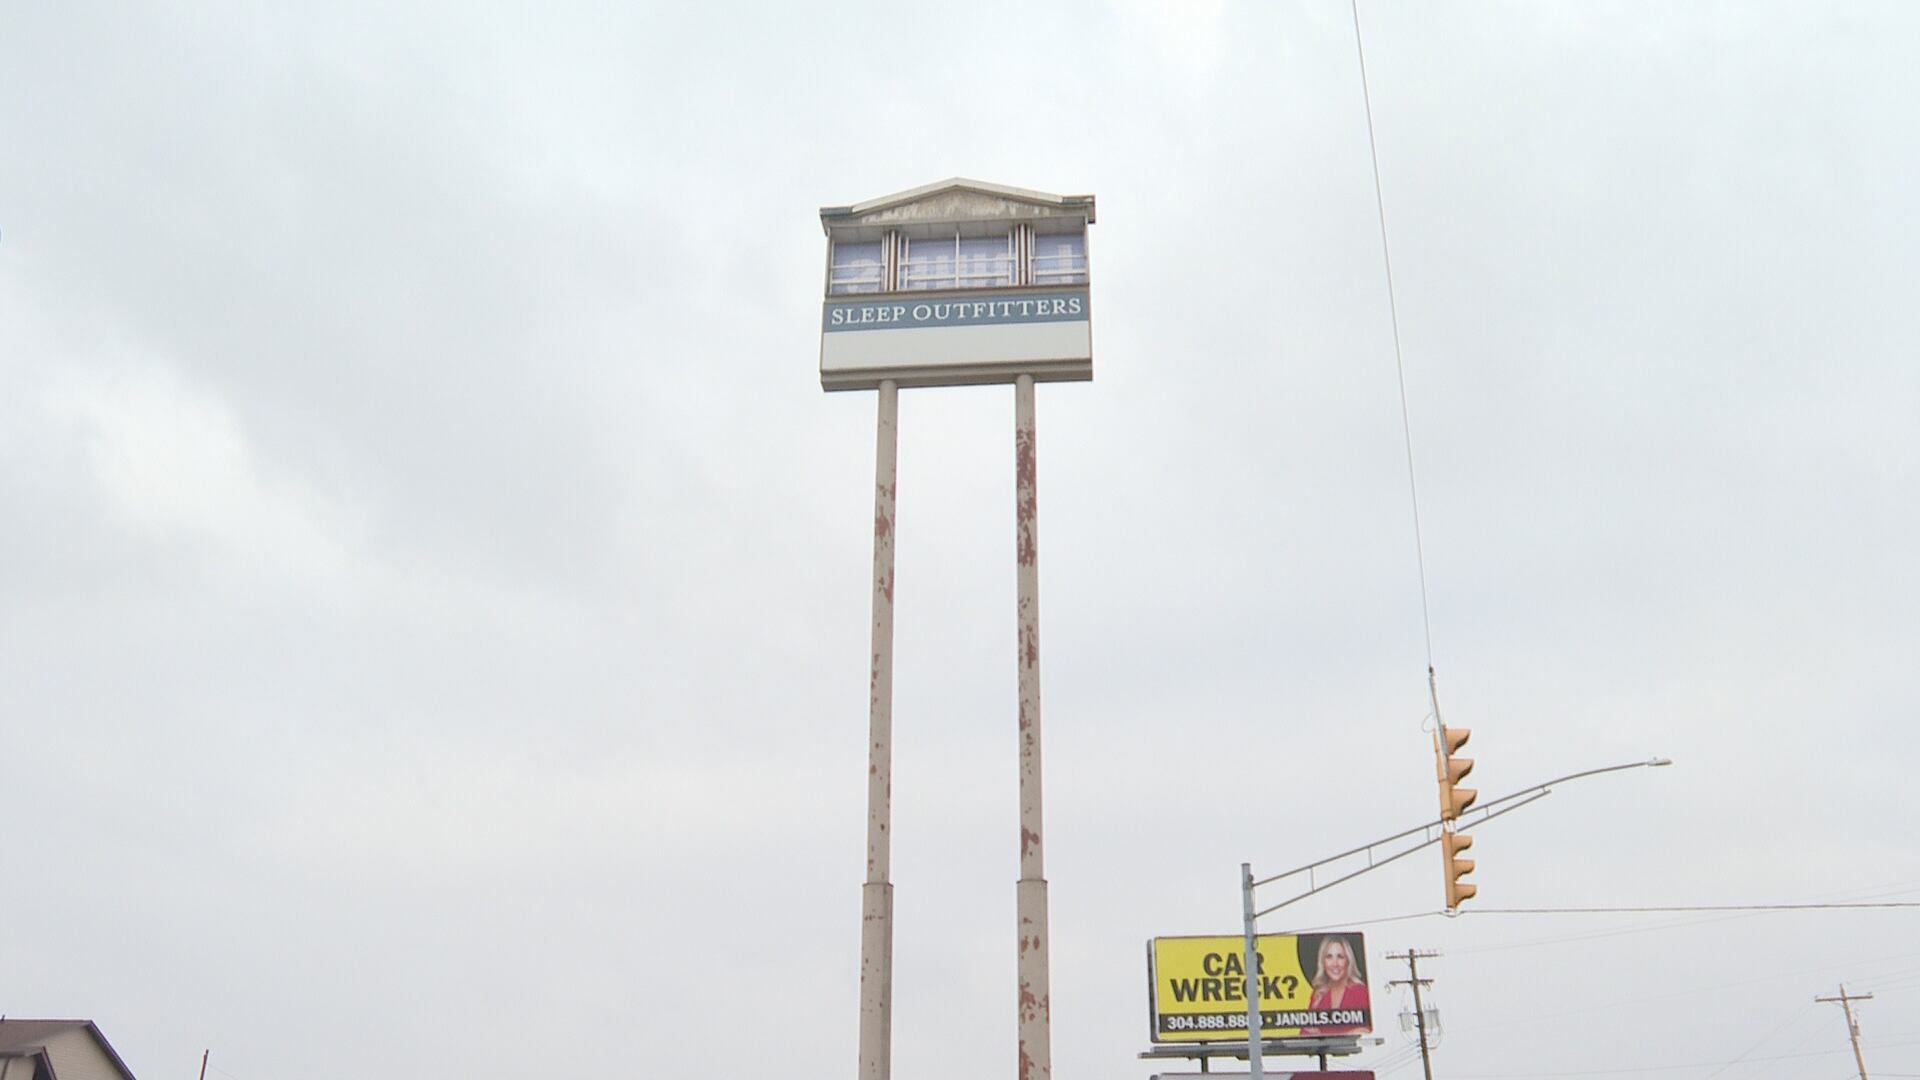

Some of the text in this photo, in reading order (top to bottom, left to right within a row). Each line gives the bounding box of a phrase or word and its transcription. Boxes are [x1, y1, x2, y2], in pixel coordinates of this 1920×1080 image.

[831, 297, 1082, 325] SLEEP OUTFITTERS
[1275, 1010, 1364, 1026] JANDILS.COM
